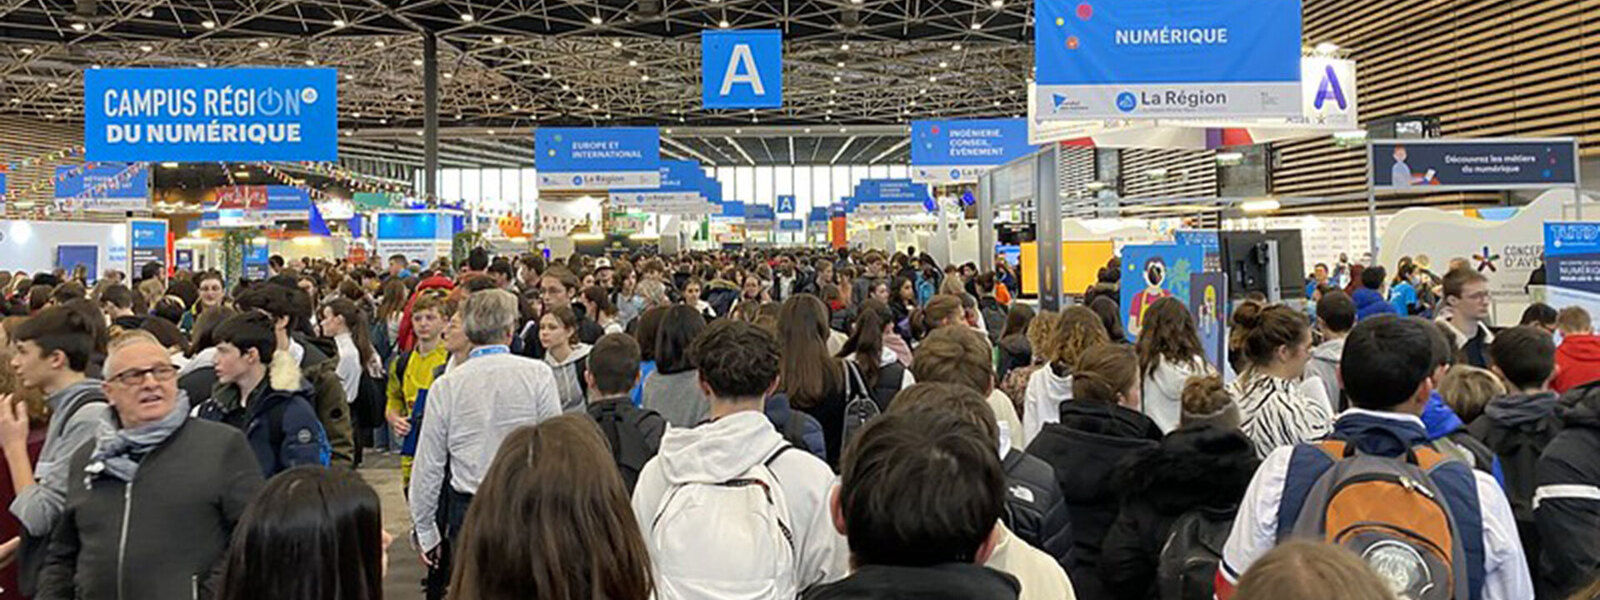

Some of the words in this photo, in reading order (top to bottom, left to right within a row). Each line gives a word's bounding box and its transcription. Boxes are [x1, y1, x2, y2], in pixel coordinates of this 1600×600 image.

[1115, 26, 1228, 45] NUMÉRIQUE
[719, 44, 765, 95] A
[1313, 65, 1348, 110] A
[103, 88, 197, 117] CAMPUS
[204, 84, 301, 117] RÉGION
[1141, 91, 1161, 106] La
[1165, 89, 1227, 108] Région
[106, 123, 141, 143] DU
[147, 119, 302, 145] NUMÉRIQUE
[572, 141, 607, 150] EUROPE
[609, 141, 620, 150] ET
[572, 150, 642, 159] INTERNATIONAL
[1444, 154, 1488, 164] Découvrez
[1489, 154, 1503, 163] les
[1504, 153, 1536, 163] métiers
[1461, 165, 1473, 173] du
[1475, 164, 1520, 174] numérique
[584, 175, 595, 183] La
[596, 174, 625, 184] Région
[780, 197, 793, 211] A
[1550, 225, 1600, 241] TUTO
[1504, 256, 1538, 268] D'AVE
